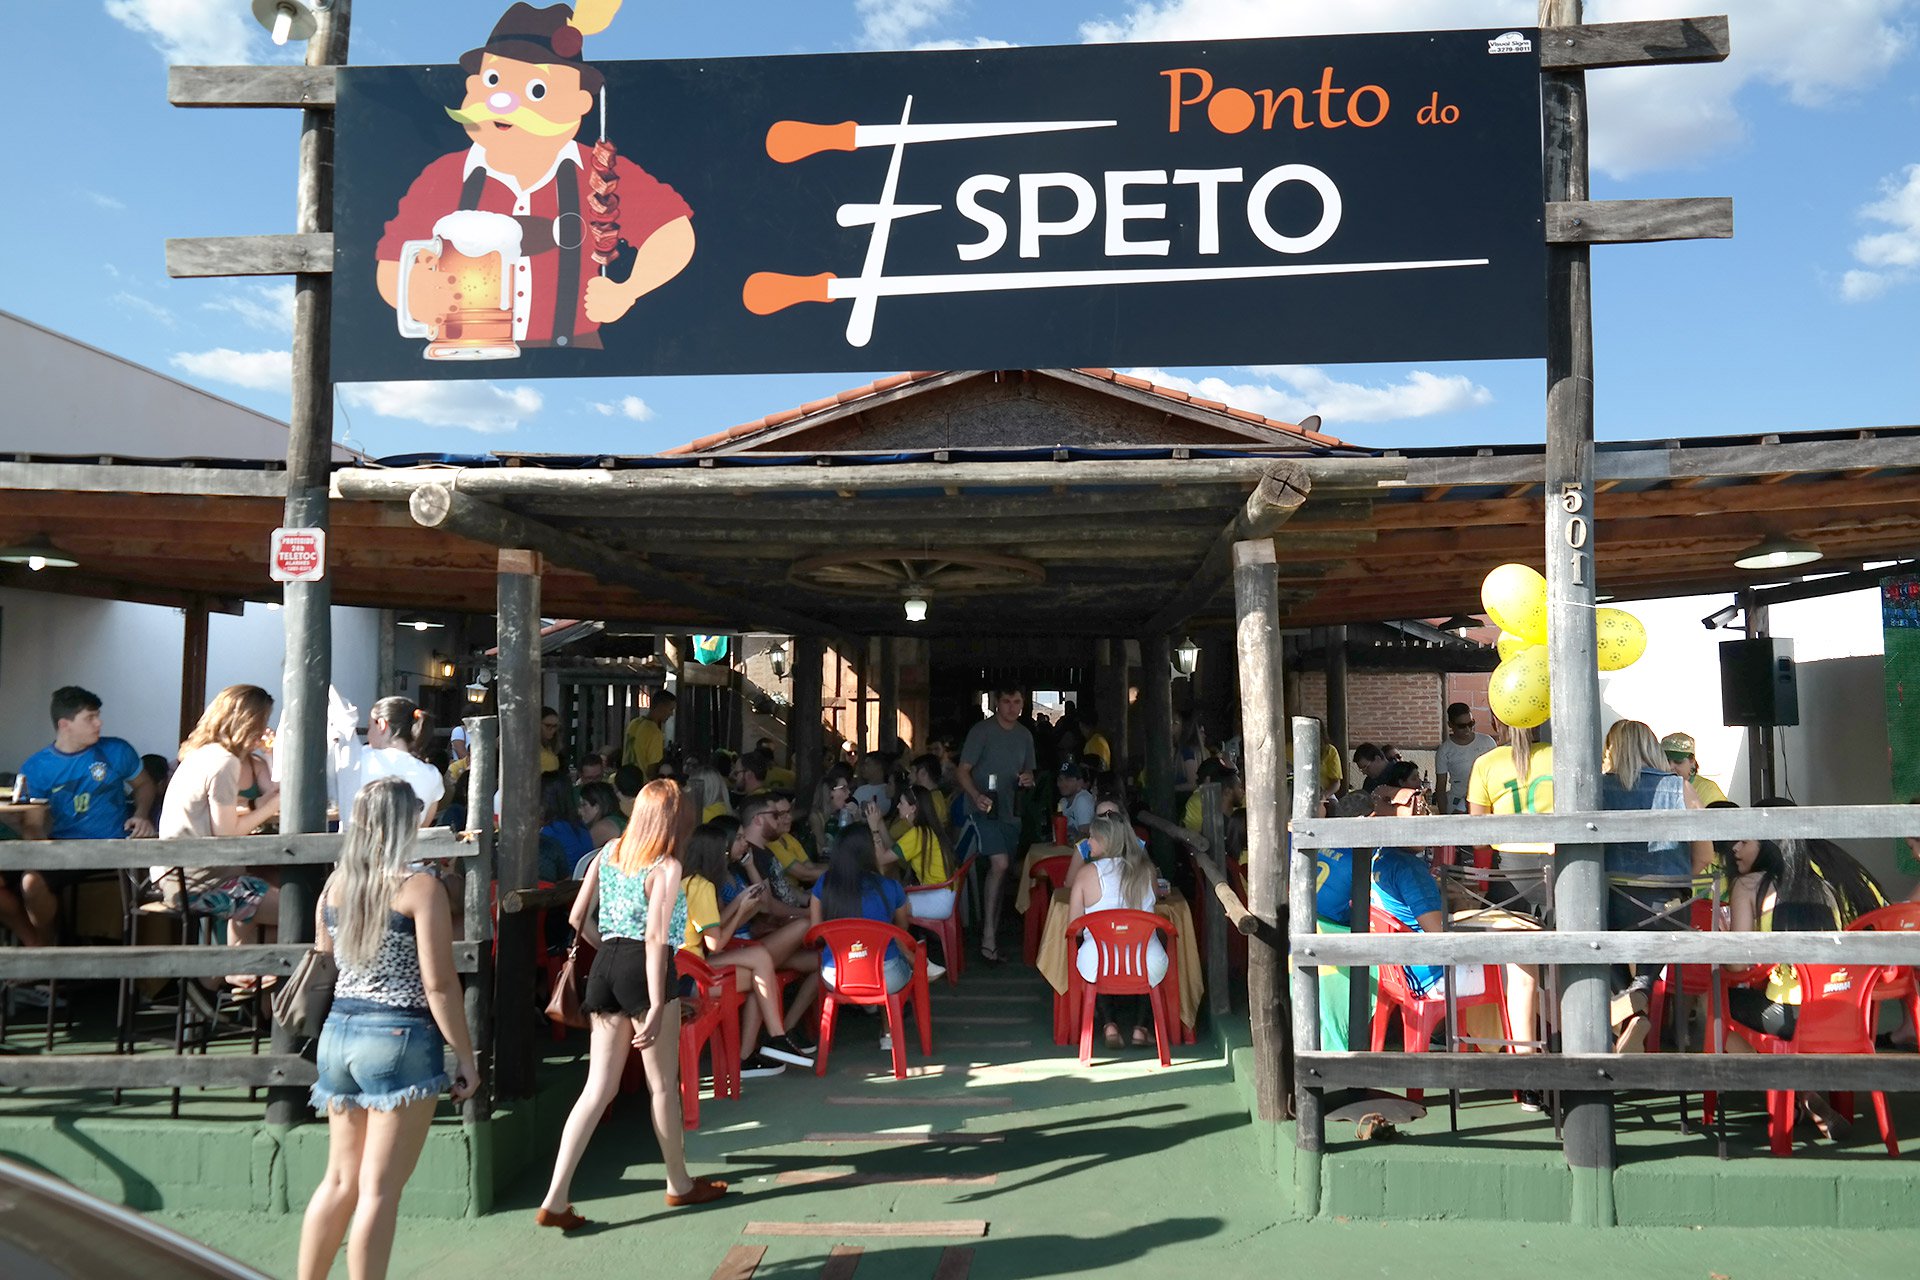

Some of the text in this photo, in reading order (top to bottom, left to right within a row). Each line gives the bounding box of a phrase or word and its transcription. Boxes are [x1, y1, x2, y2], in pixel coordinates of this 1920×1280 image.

[1160, 67, 1460, 134] Ponto do
[279, 551, 317, 561] TELETOC
[1561, 481, 1587, 585] 501
